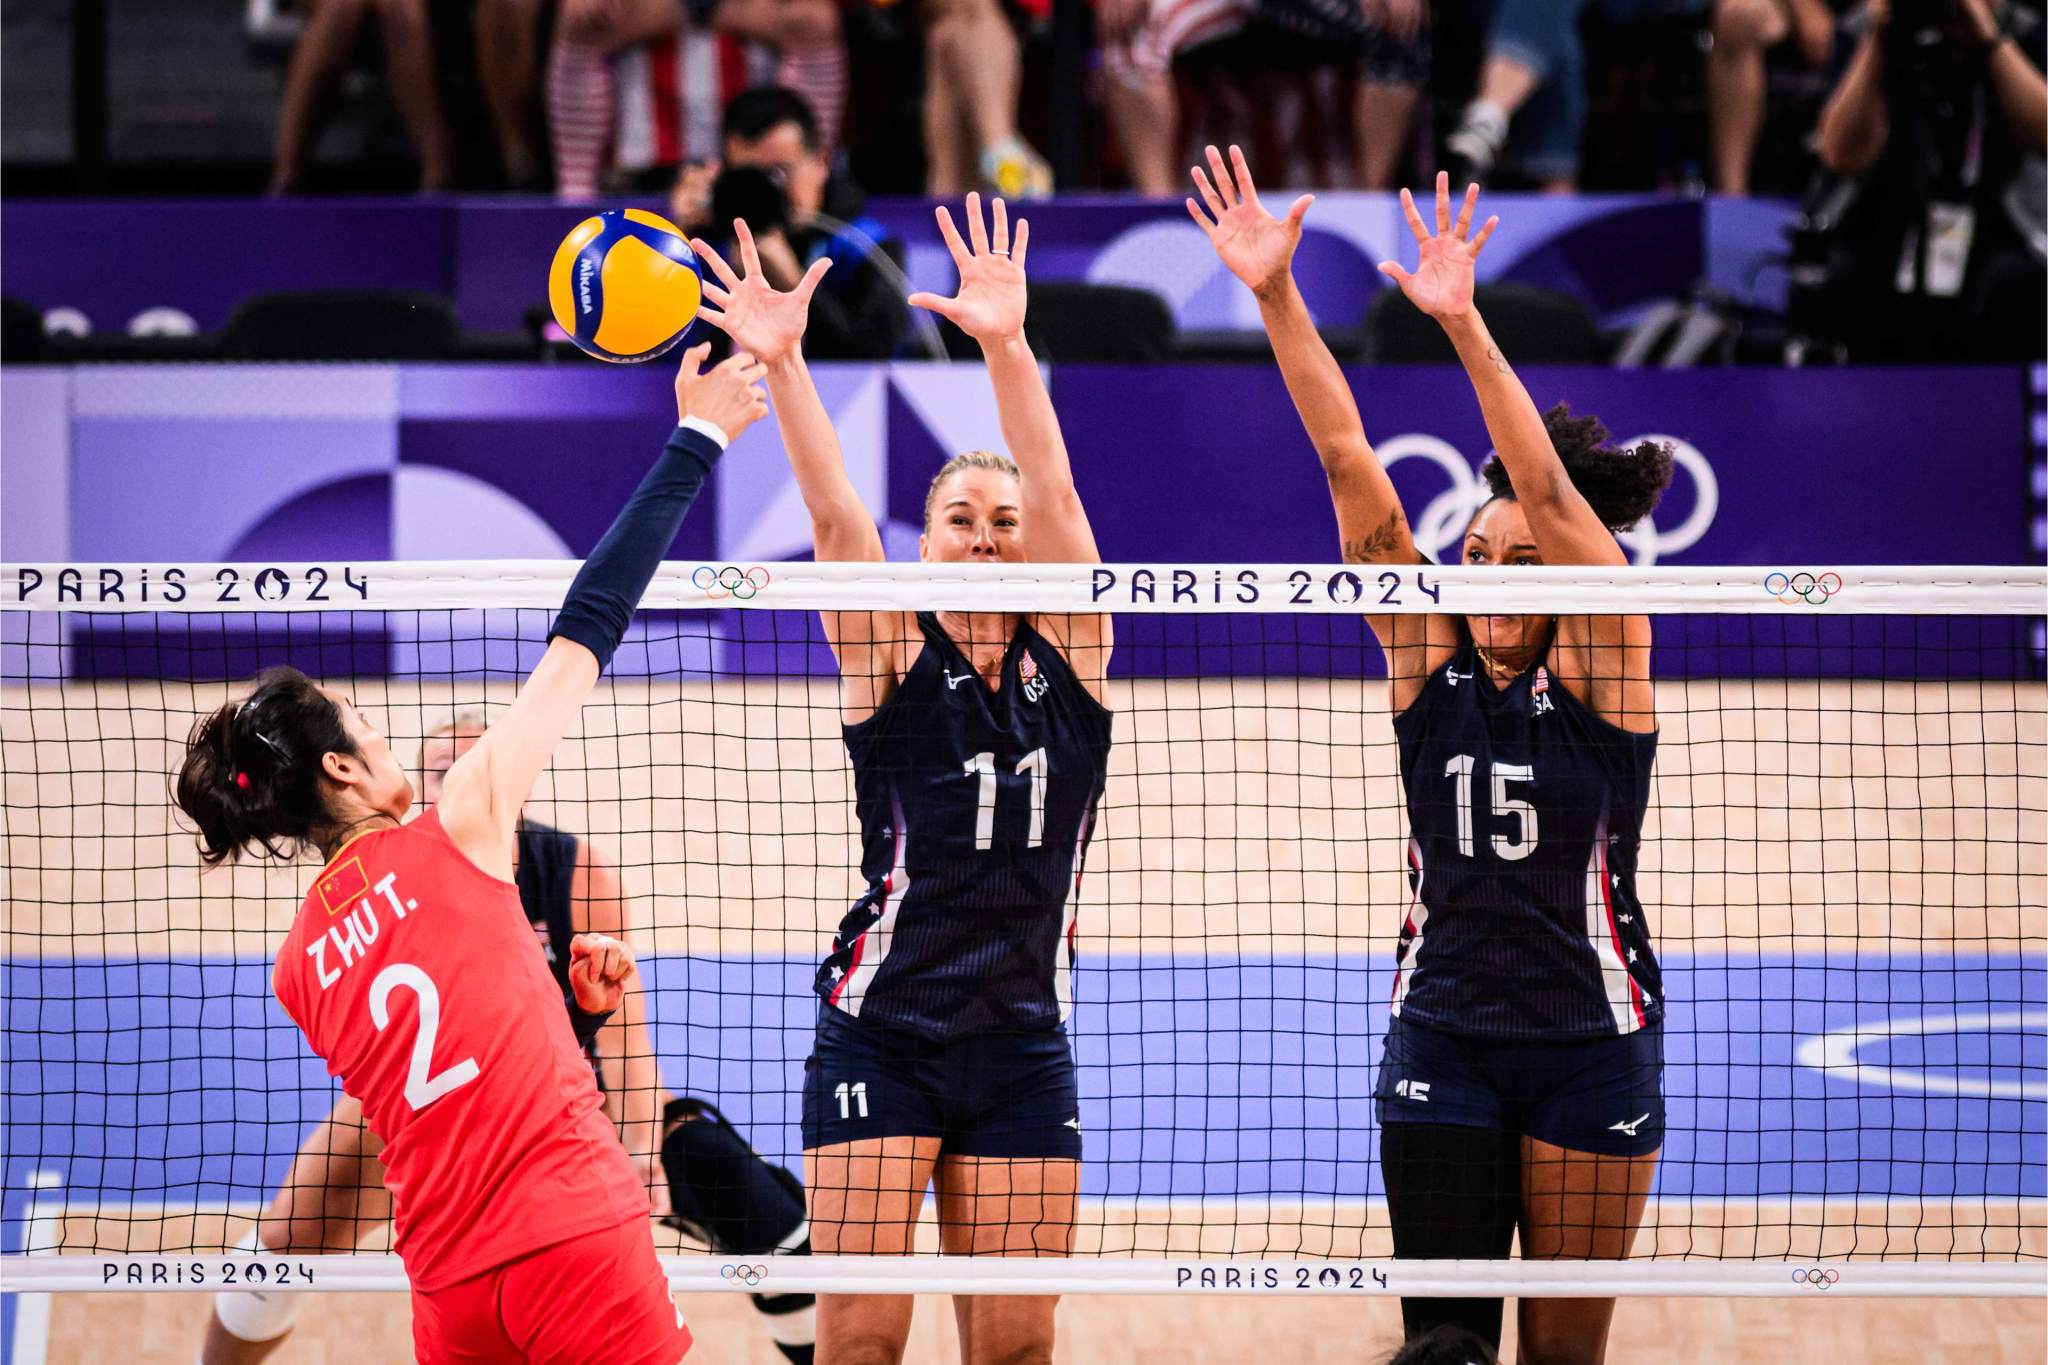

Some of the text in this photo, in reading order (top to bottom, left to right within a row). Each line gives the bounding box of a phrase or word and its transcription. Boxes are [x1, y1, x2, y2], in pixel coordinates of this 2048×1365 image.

[215, 567, 368, 603] 2024
[1288, 570, 1441, 605] 2024
[963, 747, 1049, 850] 11
[1444, 754, 1539, 861] 15
[305, 871, 418, 990] ZHU T.
[368, 963, 481, 1112] 2
[834, 1082, 869, 1119] 11
[222, 1263, 314, 1284] 2024
[1295, 1267, 1388, 1289] 2024
